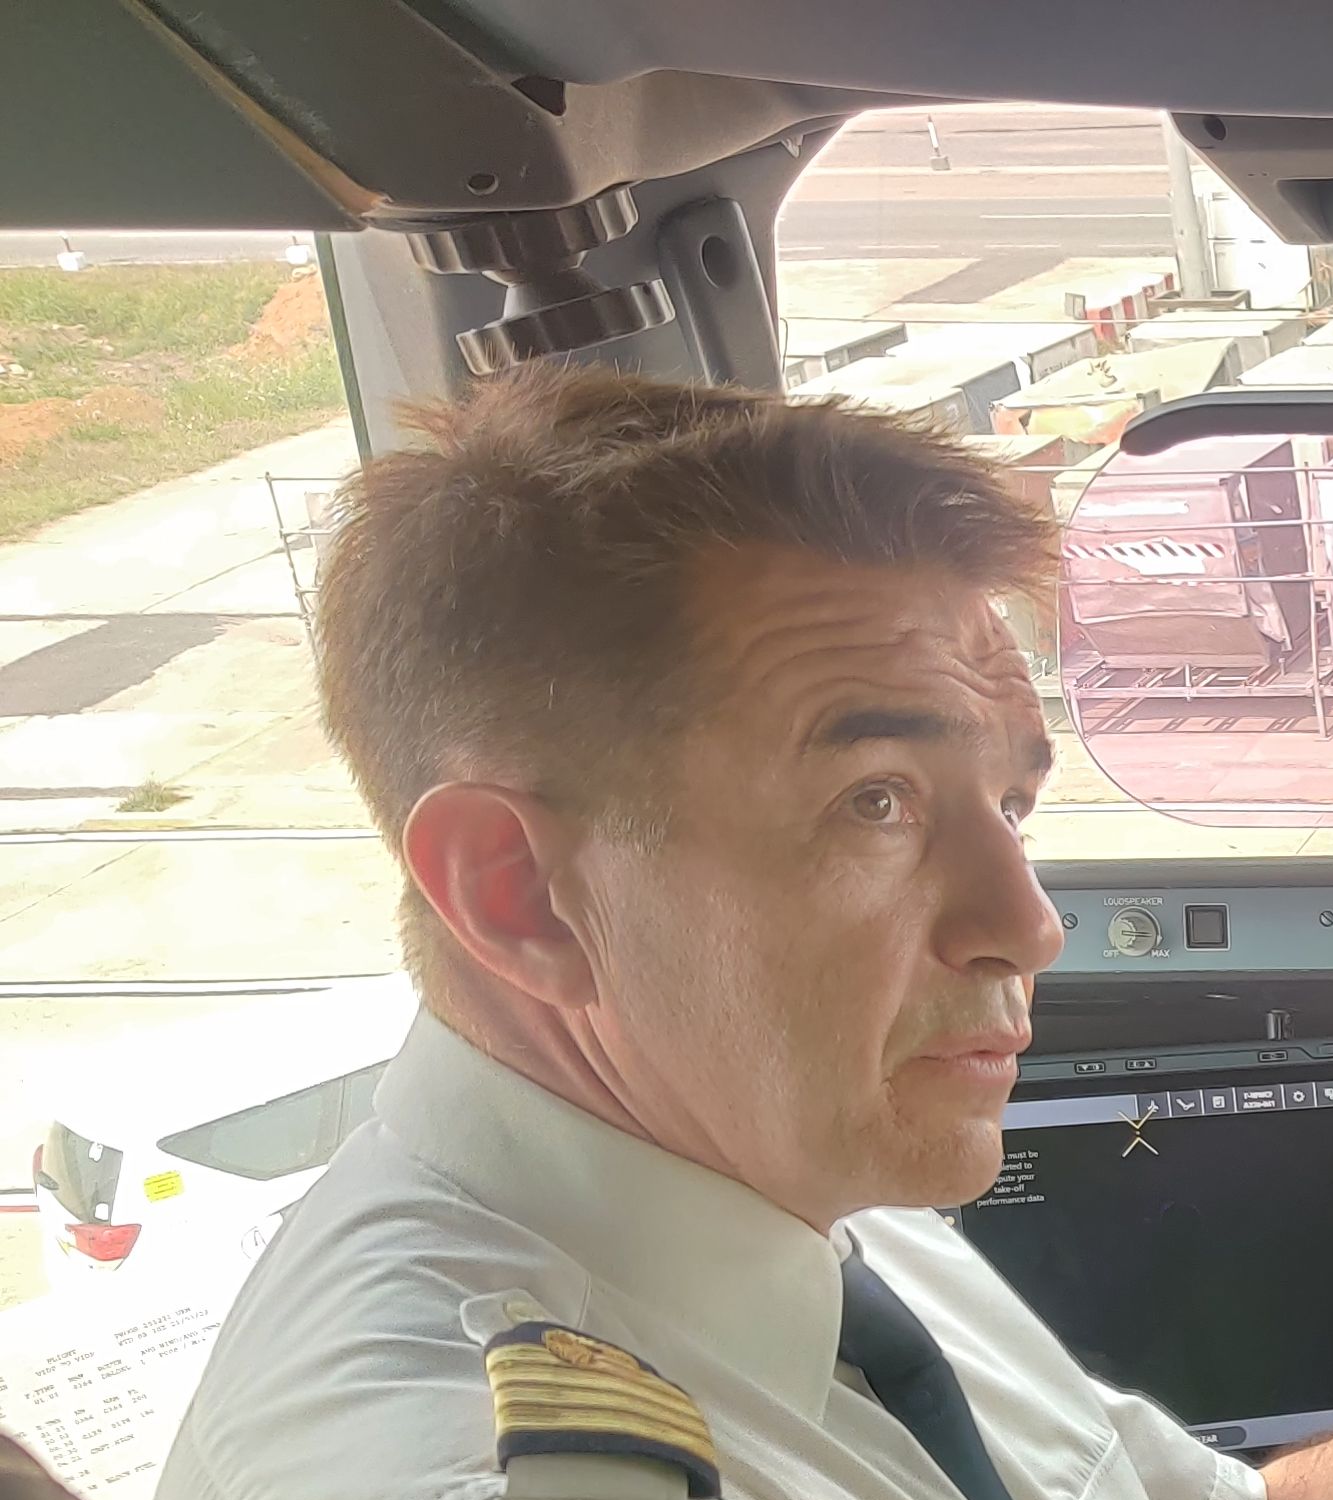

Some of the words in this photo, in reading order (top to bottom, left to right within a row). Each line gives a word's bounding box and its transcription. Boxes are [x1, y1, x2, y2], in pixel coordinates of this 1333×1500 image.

[1103, 896, 1164, 907] LOUDSPEAKER
[976, 1197, 1025, 1208] performance
[1027, 1194, 1045, 1203] data
